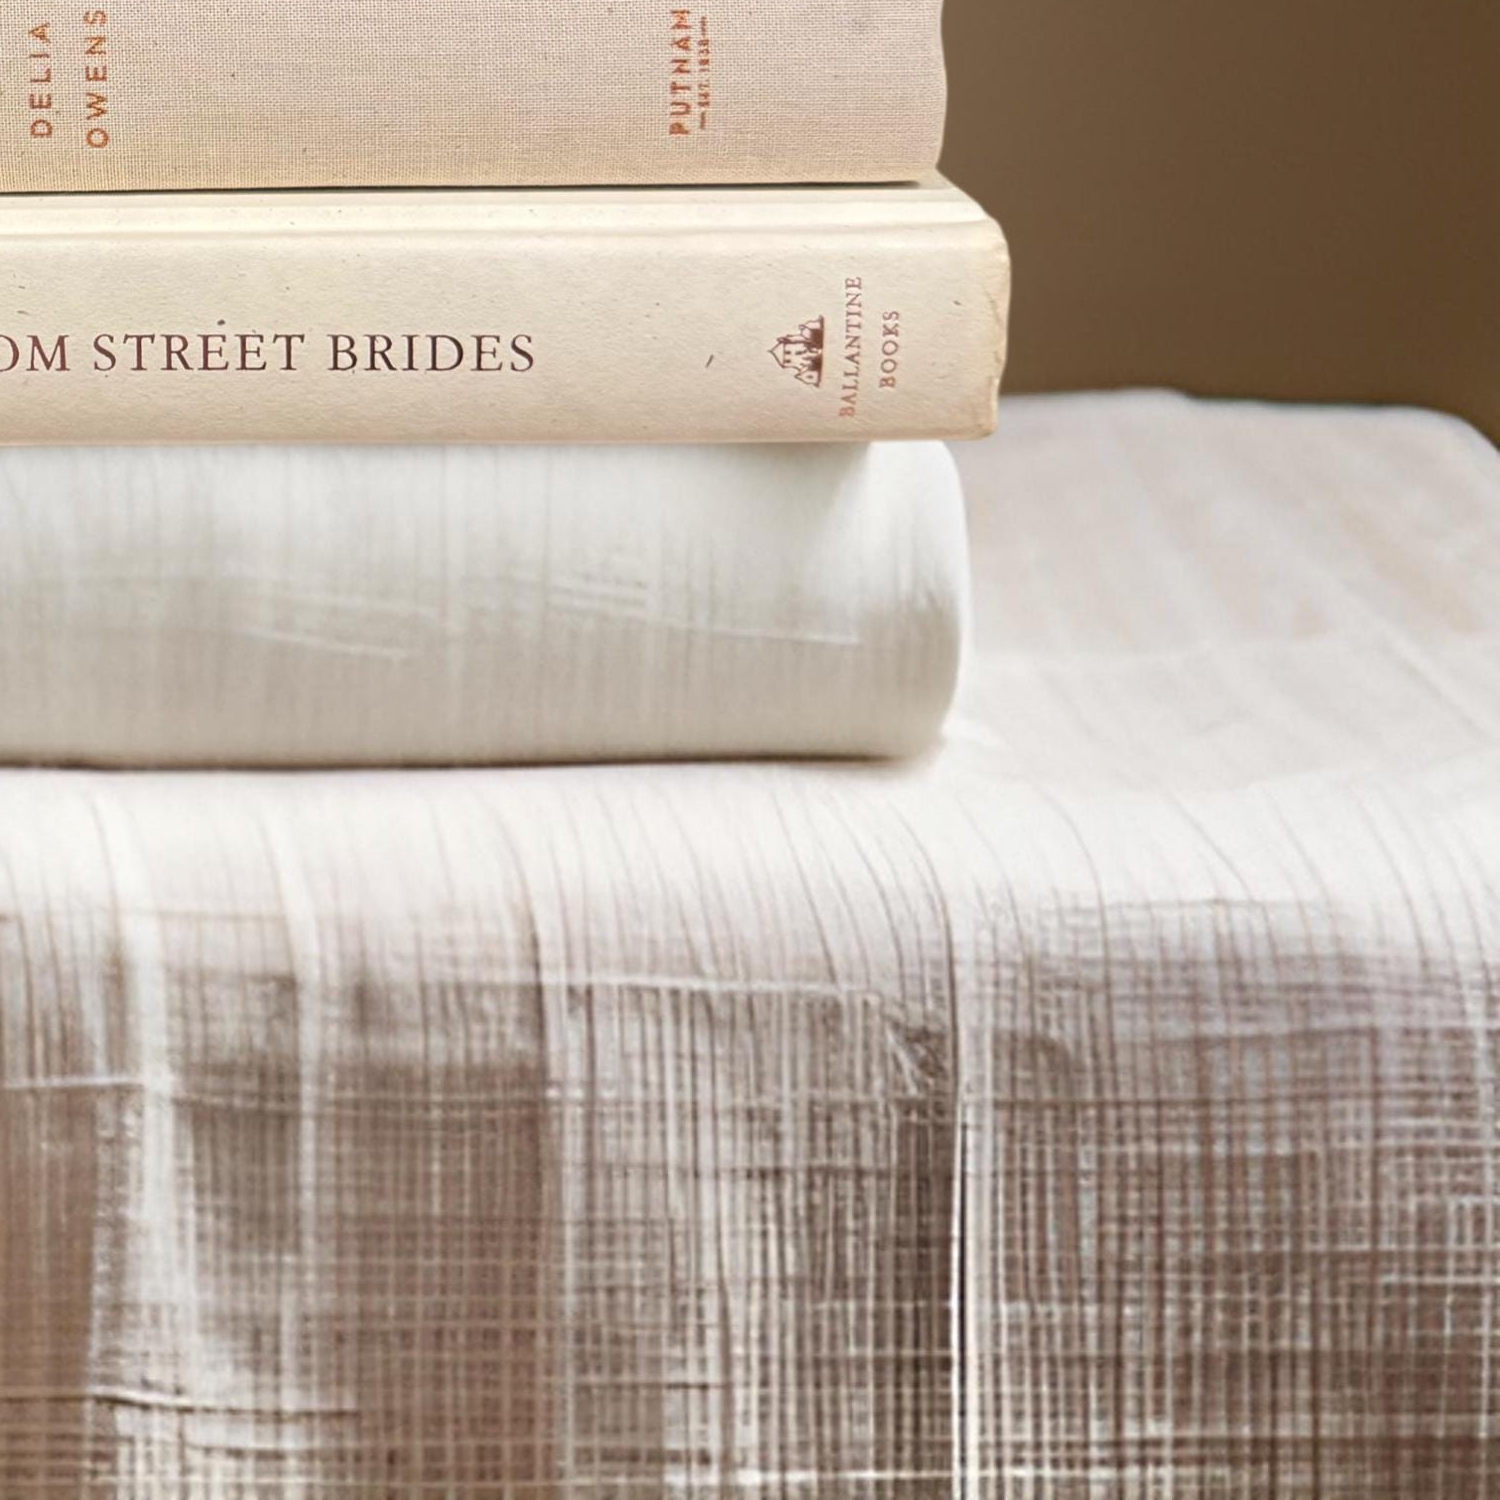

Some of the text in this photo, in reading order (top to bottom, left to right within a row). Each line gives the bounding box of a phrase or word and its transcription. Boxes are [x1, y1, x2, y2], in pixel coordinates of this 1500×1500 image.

[27, 22, 54, 139] DELIA
[83, 10, 110, 149] OWENS
[668, 9, 692, 136] PUTNAM
[93, 333, 305, 372] STREET
[329, 334, 534, 372] BRIDES
[838, 276, 863, 418] BALLANTINE
[878, 310, 900, 389] BOOKS
